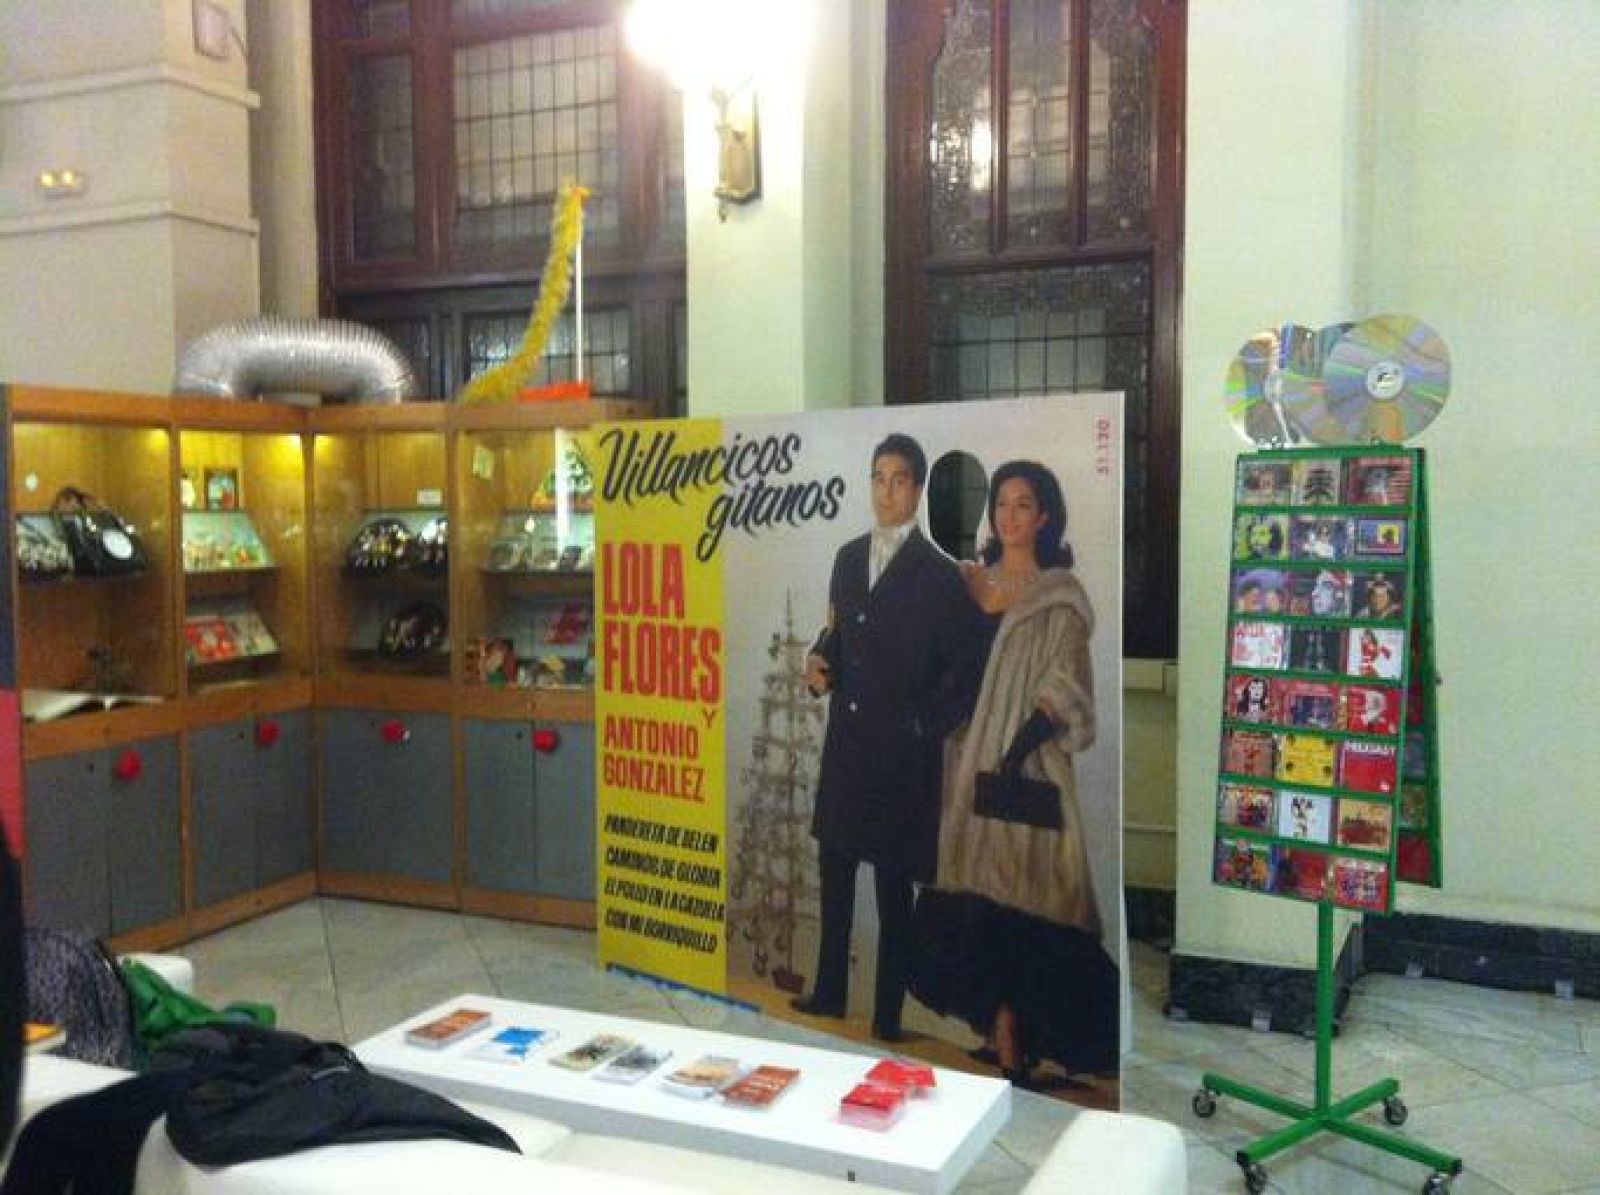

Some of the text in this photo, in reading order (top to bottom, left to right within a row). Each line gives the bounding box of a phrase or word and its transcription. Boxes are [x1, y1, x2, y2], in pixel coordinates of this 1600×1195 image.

[599, 428, 801, 507] Villancicos
[696, 476, 845, 562] gitanos
[602, 542, 685, 619] LOLA
[603, 620, 721, 704] FLORES
[604, 714, 699, 760] ANTONIO
[703, 709, 717, 728] Y
[603, 753, 705, 803] GONZALEZ
[660, 859, 677, 880] DE
